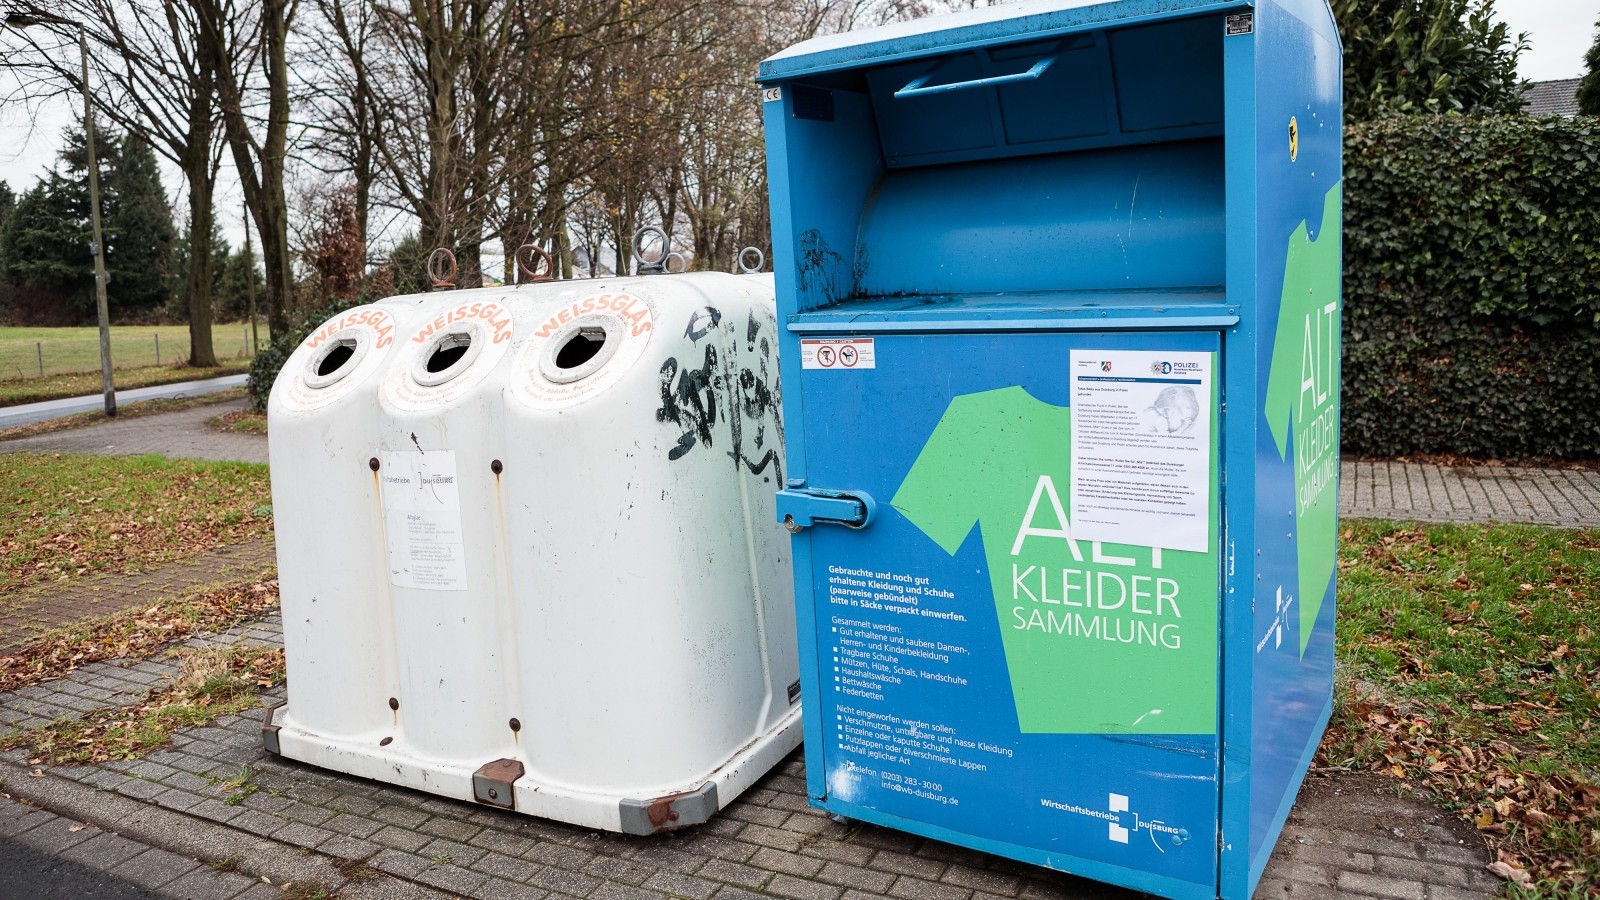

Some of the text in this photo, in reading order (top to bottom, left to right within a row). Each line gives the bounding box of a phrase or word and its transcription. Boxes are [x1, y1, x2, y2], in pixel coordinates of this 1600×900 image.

[306, 311, 393, 349] WEISSGLAS
[412, 303, 512, 344] WEISSGLAS
[535, 294, 652, 337] WEISSGLAS
[1299, 301, 1336, 423] ALT
[1299, 404, 1334, 480] KLEIDER
[1299, 451, 1334, 518] SAMMLUNG
[1010, 475, 1162, 568] AL
[829, 566, 929, 586] Gebrauchte und noch gut
[829, 576, 954, 599] erhaltene Kleidung und Schuhe
[830, 586, 918, 605] (paarweise gebündelt)
[1012, 564, 1182, 618] KLEIDER
[830, 596, 967, 622] bitte in Säcke verpackt einwerfen.
[832, 616, 902, 634] Gesammelt werden:
[1013, 606, 1181, 649] SAMMLUNG
[840, 626, 970, 655] Gut erhaltene und saubere Damen-,
[840, 637, 949, 663] Herren- und Kinderbekleidung
[840, 647, 898, 663] Tragbare Schuhe
[841, 656, 968, 685] Mützen, Hüte, Schals, Handschuhe
[841, 667, 901, 684] Haushaltswäsche
[842, 677, 882, 690] Bettwäsche
[843, 686, 884, 701] Federbetten
[836, 704, 956, 734] Nicht eingeworfen werden sollen:
[844, 716, 1013, 758] Verschmutzte, untragbare und nasse Kleidung
[845, 724, 950, 753] Einzelne oder kaputte Schuhe
[846, 734, 987, 772] Putzlappen oder ölverschmierte Lappen
[848, 744, 910, 765] Abfall jeglicher Art
[881, 770, 902, 782] (0203)
[904, 776, 918, 786] 283
[881, 782, 959, 806] info@wb-duisburg.de
[1041, 798, 1120, 822] Wirtschaftsbetriebe
